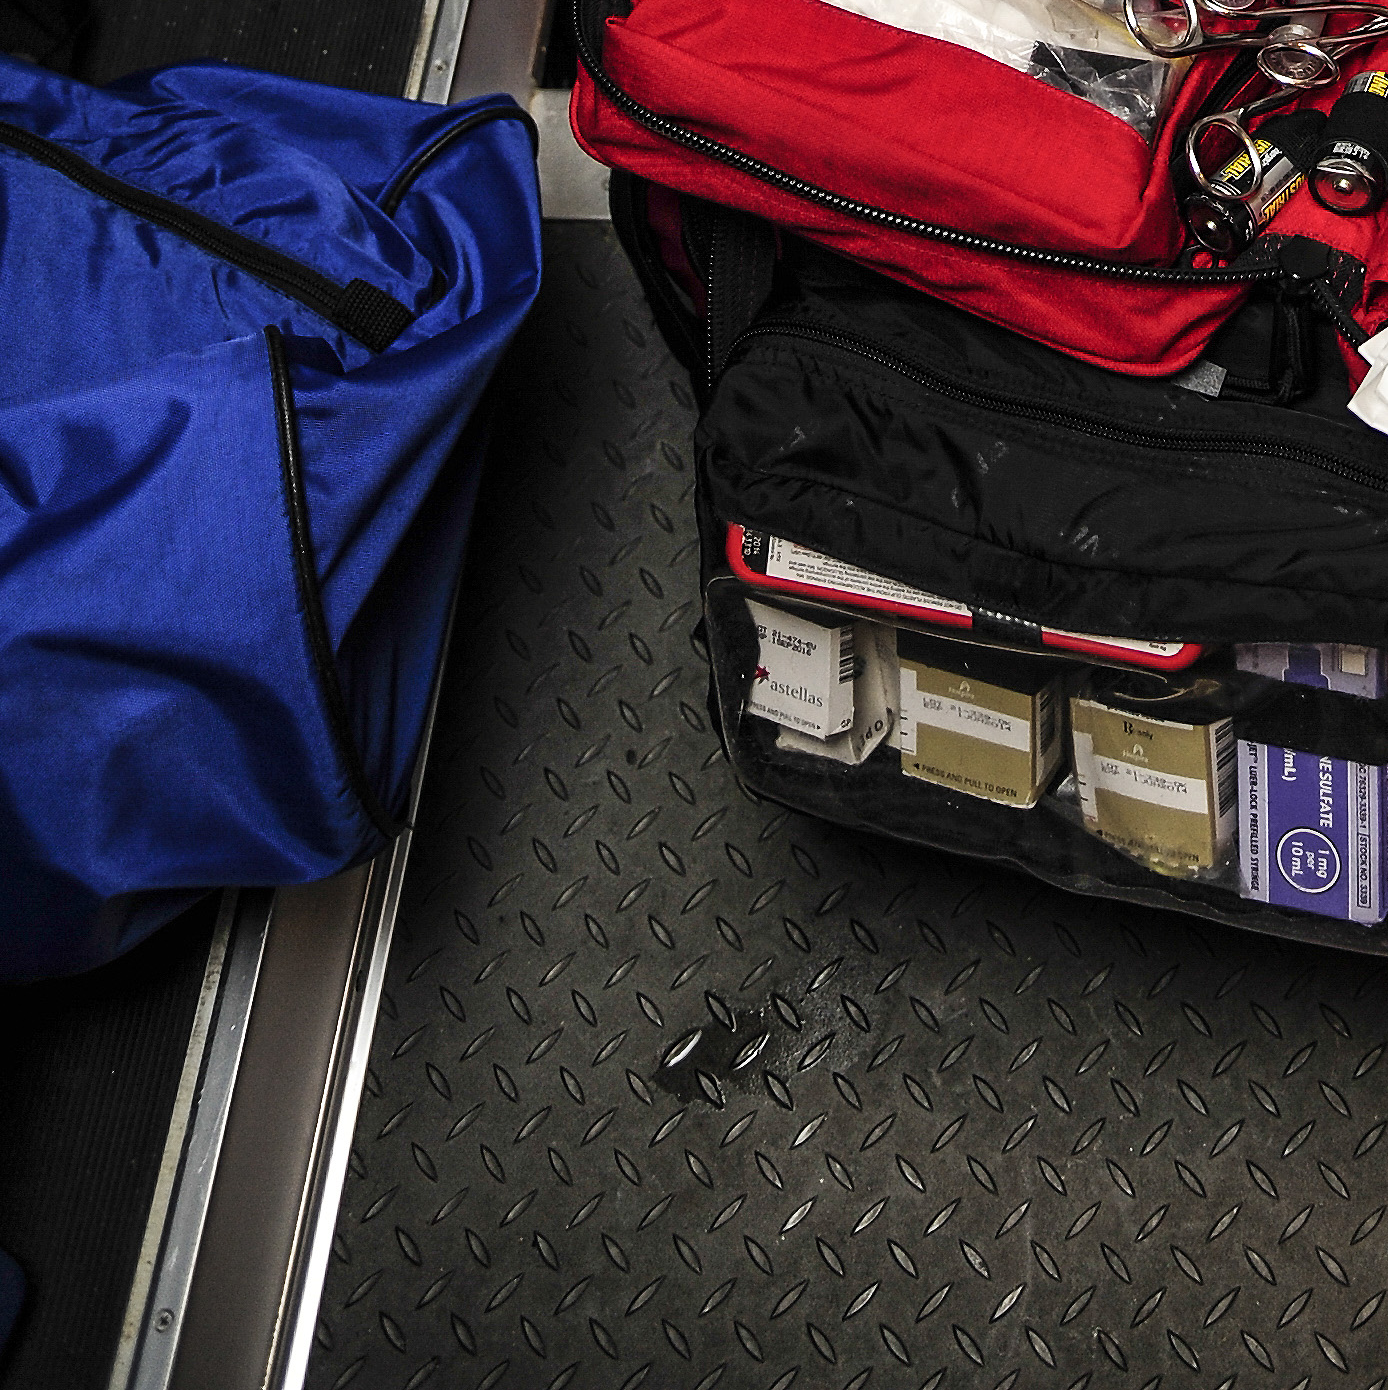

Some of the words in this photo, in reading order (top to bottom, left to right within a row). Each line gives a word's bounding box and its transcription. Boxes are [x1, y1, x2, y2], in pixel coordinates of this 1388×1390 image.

[770, 680, 824, 708] astellas
[921, 763, 945, 779] PRESS
[946, 771, 963, 784] AND
[964, 777, 983, 791] PULL
[984, 782, 995, 793] TO
[995, 785, 1018, 798] OPEN
[1306, 851, 1316, 870] per
[1359, 836, 1369, 863] STOCK
[1316, 856, 1329, 879] mg
